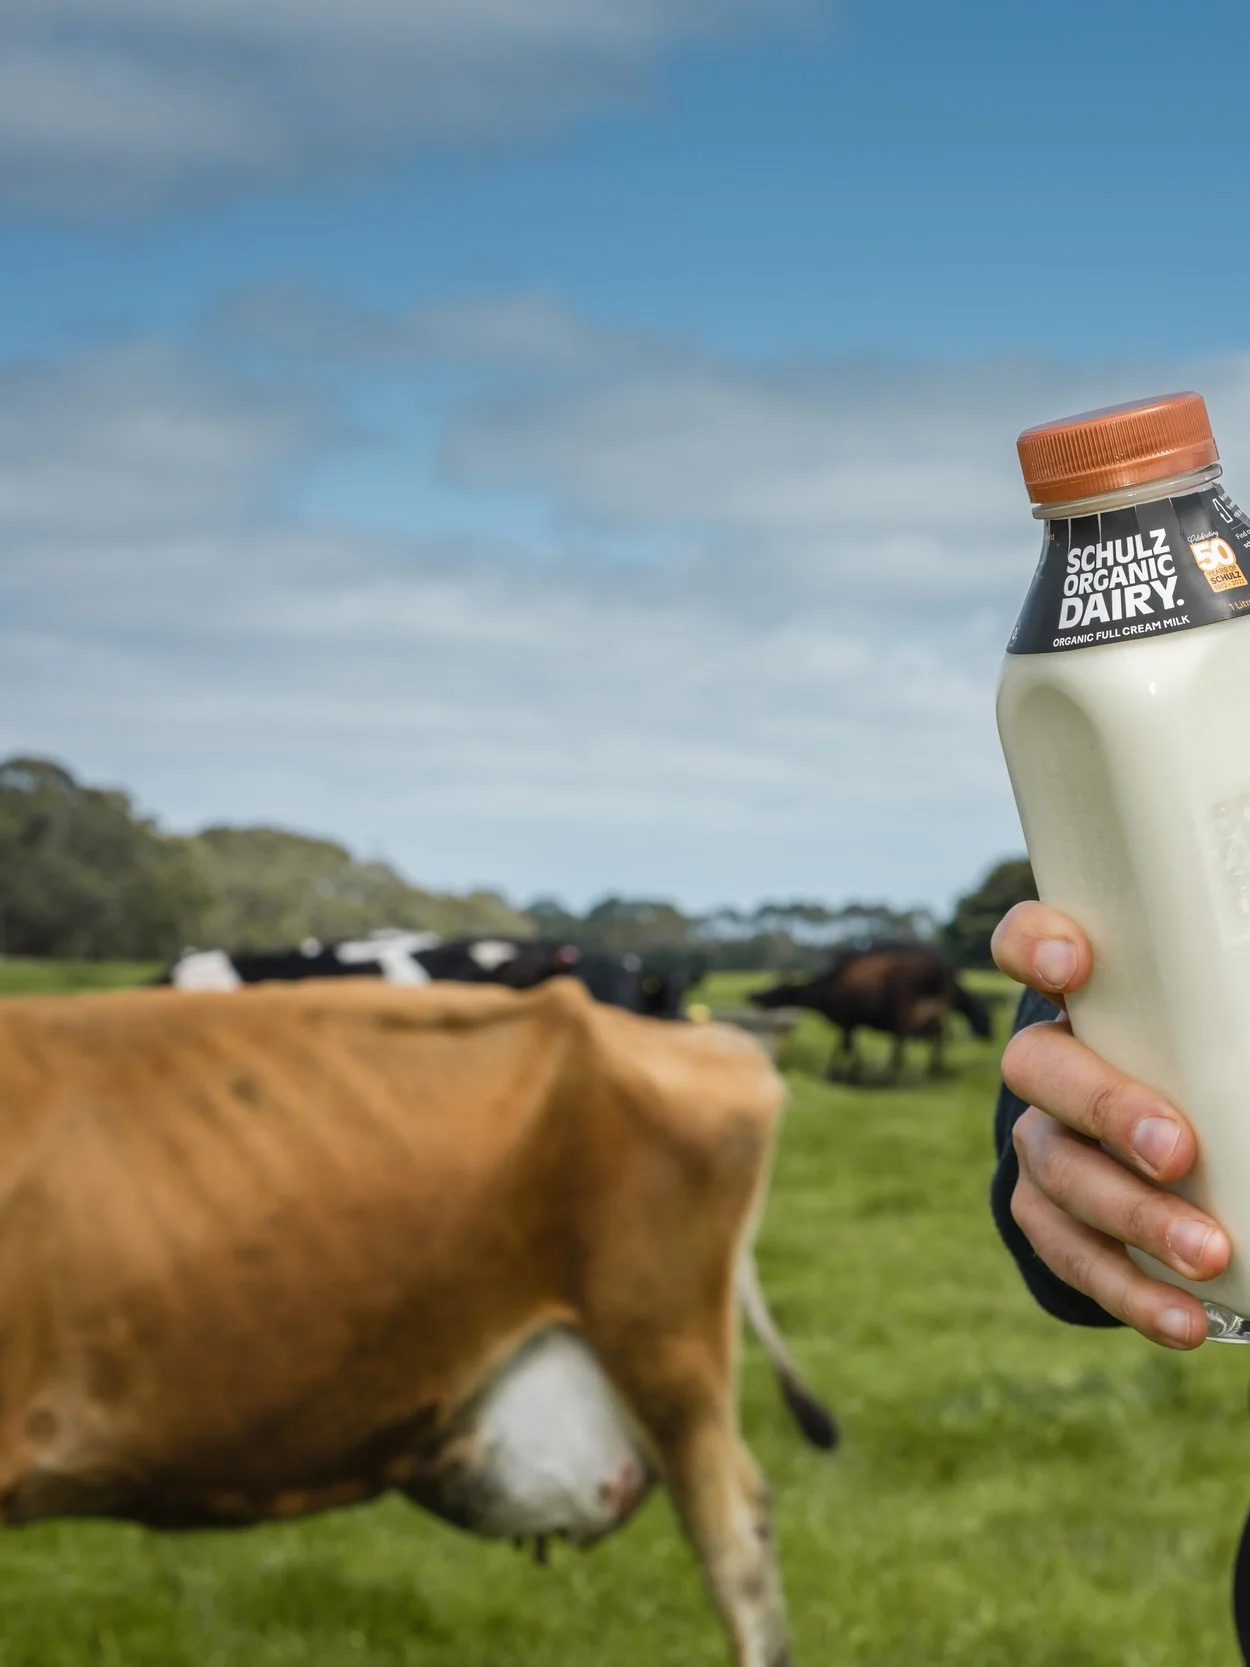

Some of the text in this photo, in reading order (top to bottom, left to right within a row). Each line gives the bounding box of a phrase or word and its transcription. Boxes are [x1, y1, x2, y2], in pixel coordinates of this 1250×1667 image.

[1187, 530, 1219, 544] Celebrating
[1066, 528, 1170, 574] SCHULZ
[1191, 538, 1236, 570] 50
[1063, 554, 1176, 597] ORGANIC
[1207, 567, 1228, 578] YEARS
[1210, 571, 1242, 585] SCHULZ
[1214, 578, 1245, 590] 1972 2022
[1058, 575, 1185, 629] DAIRY.
[1228, 603, 1235, 612] 1
[1052, 615, 1190, 648] ORGANIC FULL CREAM MILK
